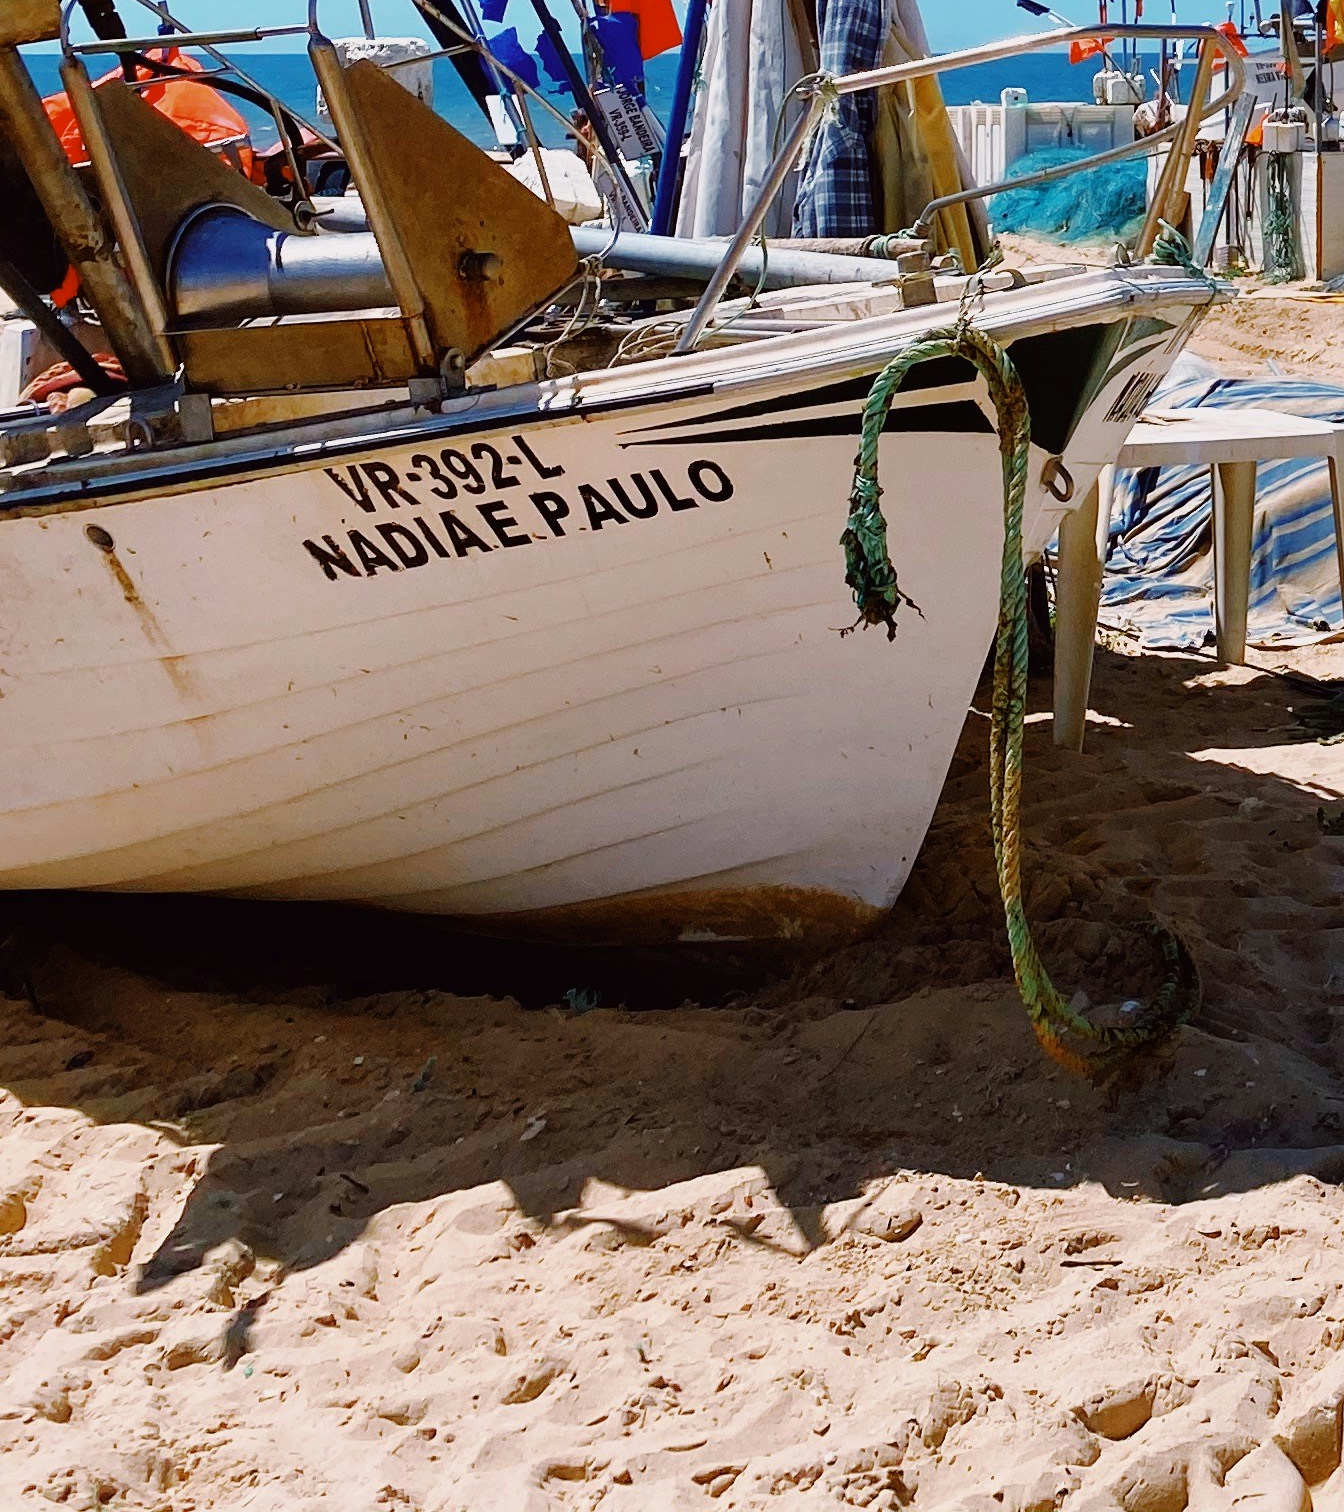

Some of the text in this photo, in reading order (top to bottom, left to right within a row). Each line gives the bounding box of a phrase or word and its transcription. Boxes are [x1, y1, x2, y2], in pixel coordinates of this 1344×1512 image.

[301, 509, 494, 581] NADIA
[529, 459, 735, 538] PAULO
[323, 434, 566, 513] VR-392-L
